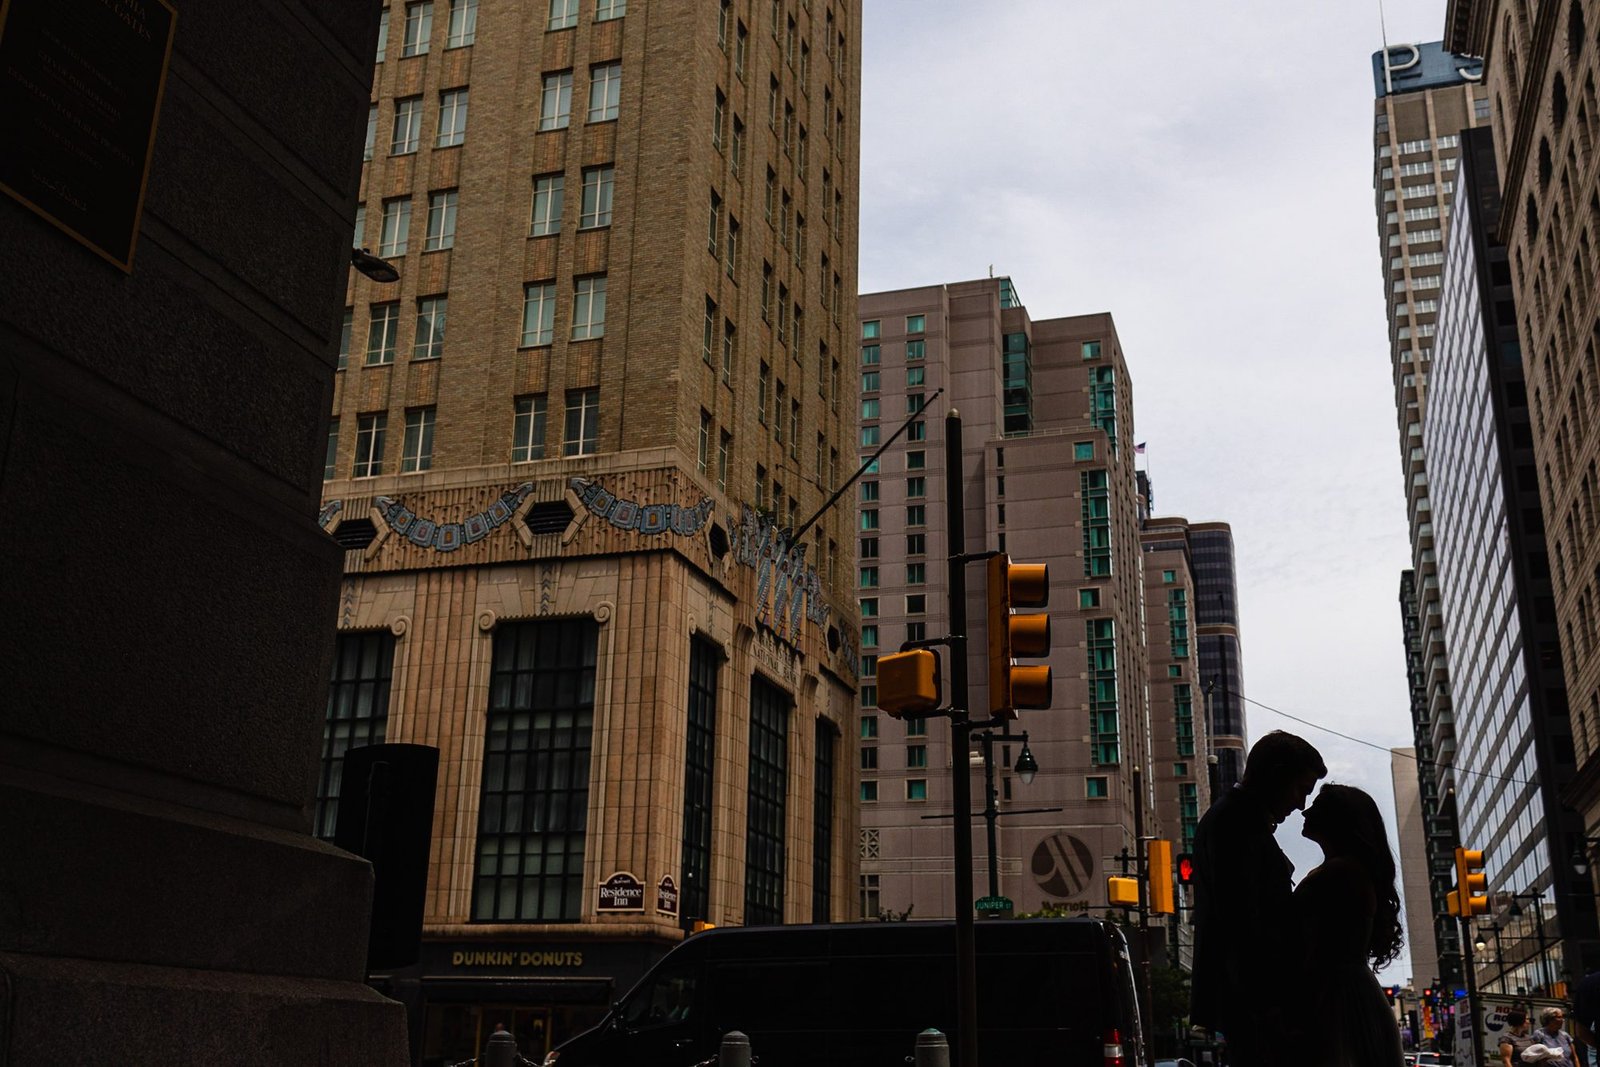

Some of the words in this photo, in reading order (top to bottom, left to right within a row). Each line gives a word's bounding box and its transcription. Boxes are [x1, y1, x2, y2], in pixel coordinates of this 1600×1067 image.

[600, 887, 642, 898] Residence
[613, 896, 628, 906] Inn
[976, 901, 1004, 910] JUNIPER
[1041, 901, 1089, 911] Marriott
[451, 951, 518, 967] DUNKIN'
[519, 951, 584, 967] DONUTS
